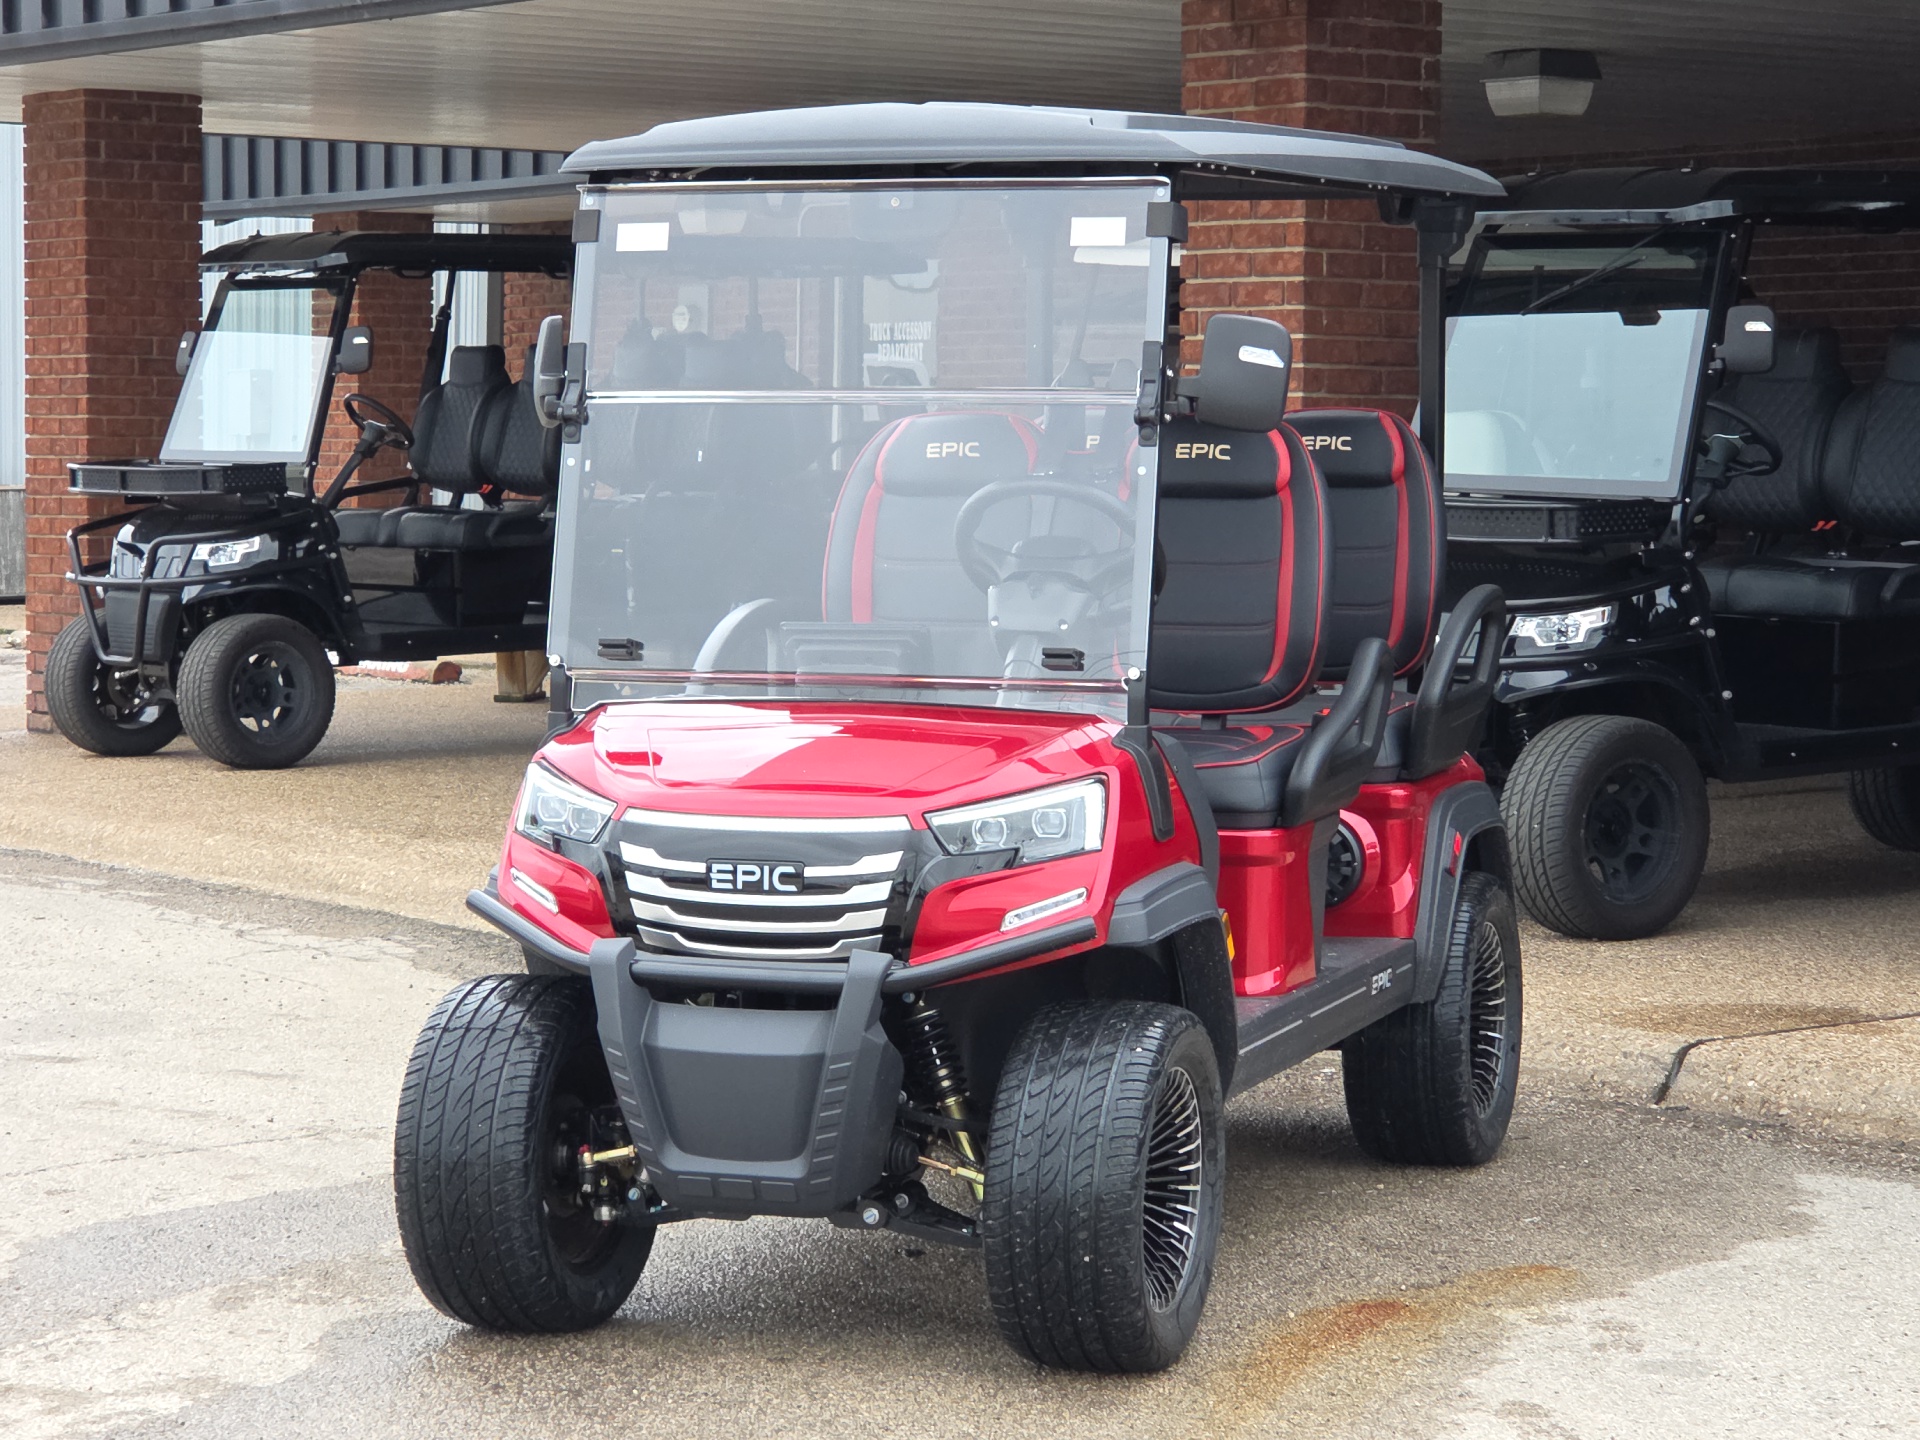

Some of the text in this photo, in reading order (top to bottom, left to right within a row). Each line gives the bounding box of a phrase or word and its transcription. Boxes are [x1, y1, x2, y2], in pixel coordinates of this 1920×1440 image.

[869, 321, 932, 341] TRUCK ACCESSORY
[877, 343, 924, 361] DEPARTMENT
[926, 442, 980, 458] EPIC
[1175, 443, 1231, 460] EPIC
[1302, 436, 1352, 450] EPIC
[709, 863, 798, 892] EPIC
[1371, 968, 1392, 995] EPIC
